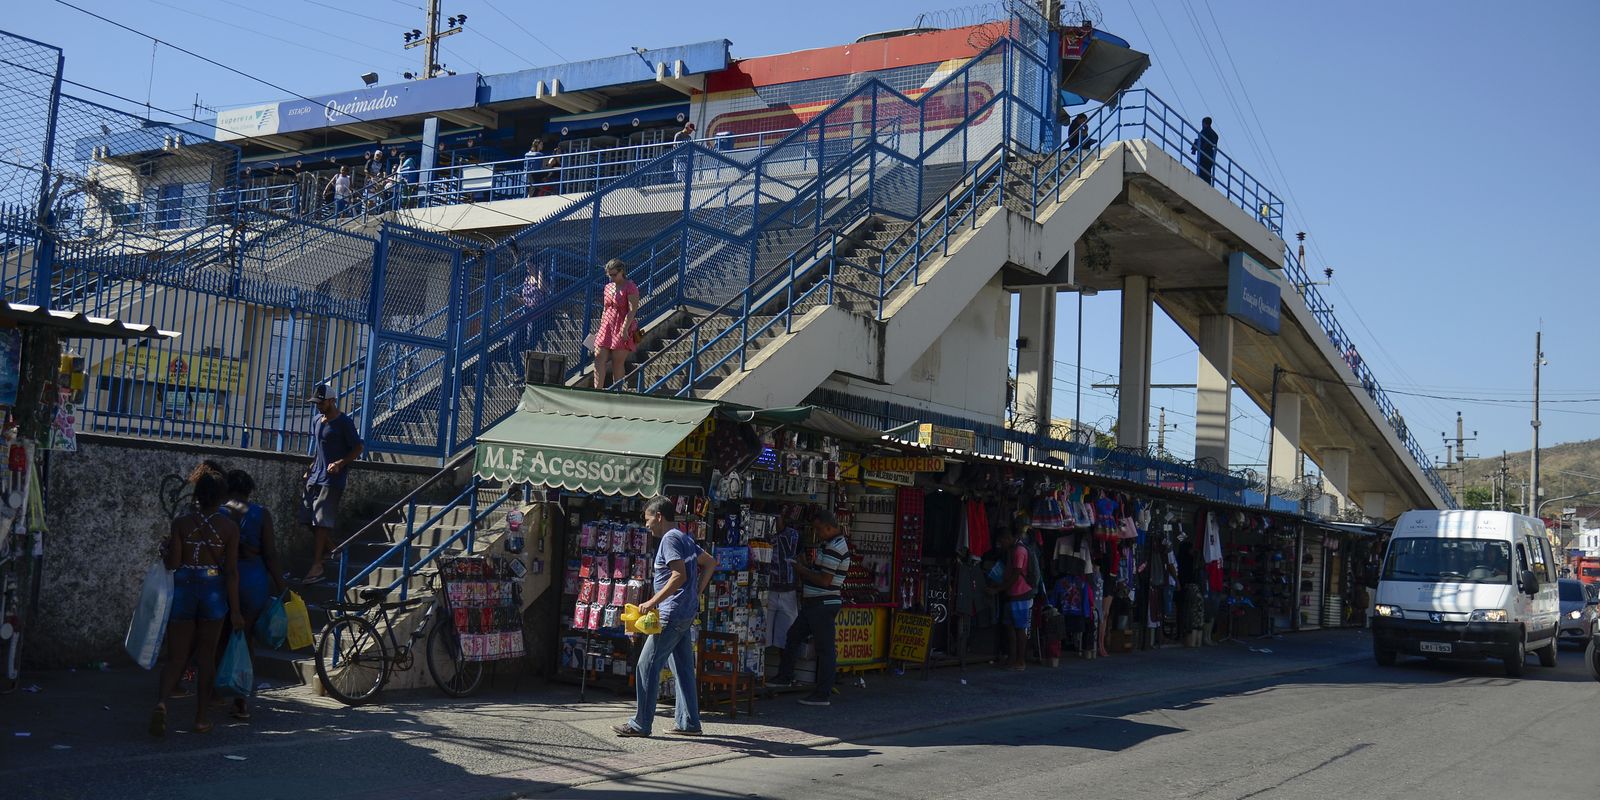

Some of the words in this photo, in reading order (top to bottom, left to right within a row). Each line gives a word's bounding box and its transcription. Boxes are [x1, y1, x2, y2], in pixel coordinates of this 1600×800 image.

[288, 105, 311, 116] ESTAÇÃO
[324, 89, 398, 122] Queimados
[530, 450, 655, 486] Acessórios
[844, 645, 872, 658] BATERIAS
